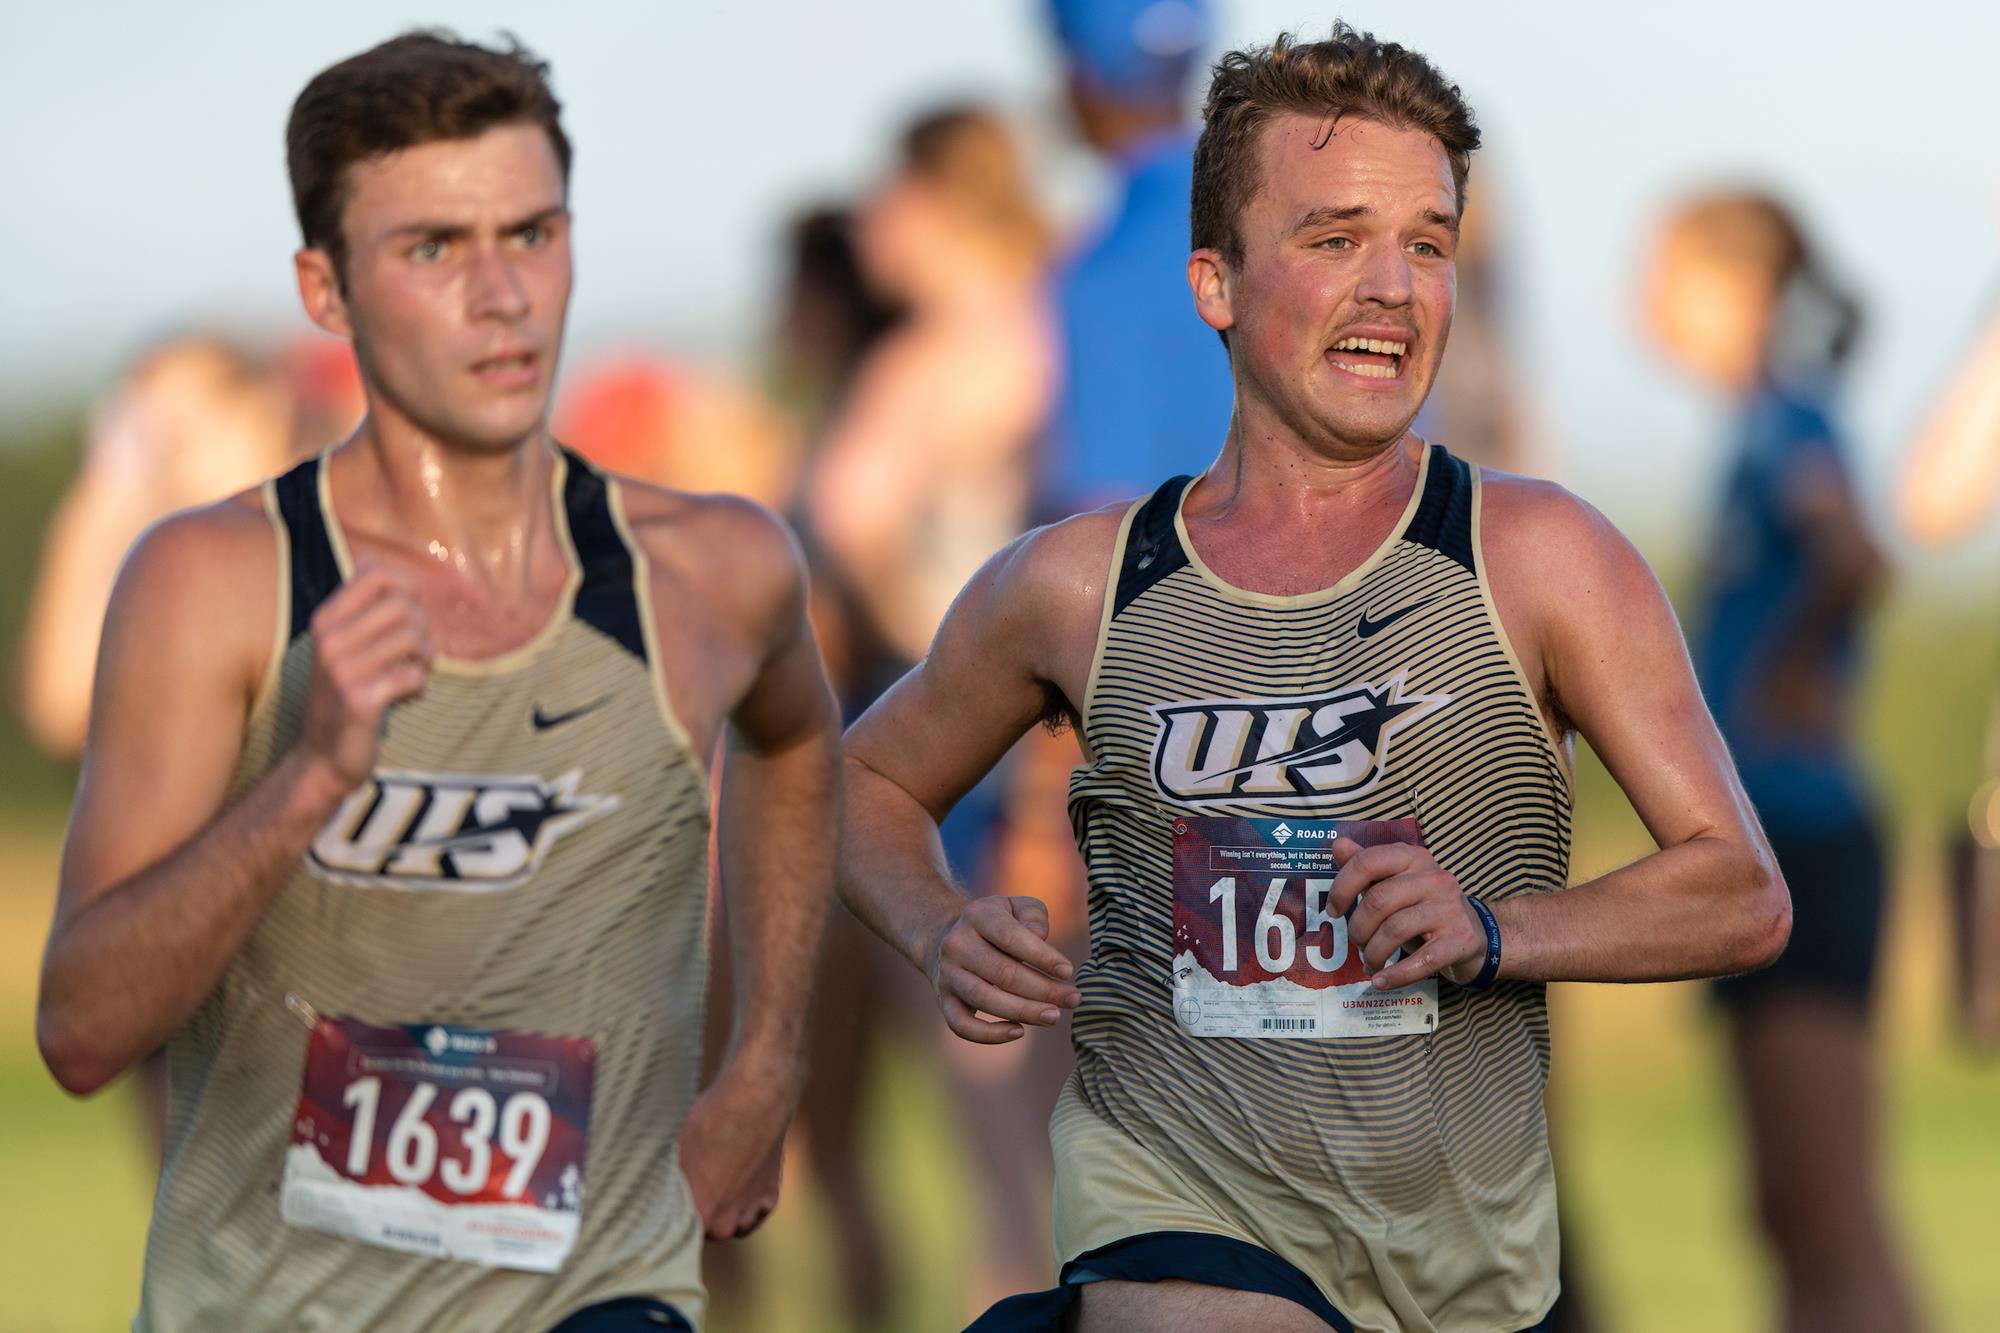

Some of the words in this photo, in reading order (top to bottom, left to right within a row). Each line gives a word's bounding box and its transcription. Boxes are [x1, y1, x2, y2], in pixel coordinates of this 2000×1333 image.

[1150, 685, 1388, 805] UIS
[305, 774, 548, 891] UIS
[1297, 829, 1325, 839] ROAD
[1220, 850, 1241, 860] Winning
[1255, 851, 1287, 861] everything,
[1288, 851, 1298, 860] but
[1304, 852, 1321, 860] beats
[1322, 853, 1335, 861] any
[1270, 862, 1292, 870] second.
[1295, 862, 1312, 870] -Paul
[1312, 863, 1333, 871] Bryant
[1342, 997, 1424, 1009] U3MN2ZCHYPSR
[343, 1076, 551, 1199] 1639
